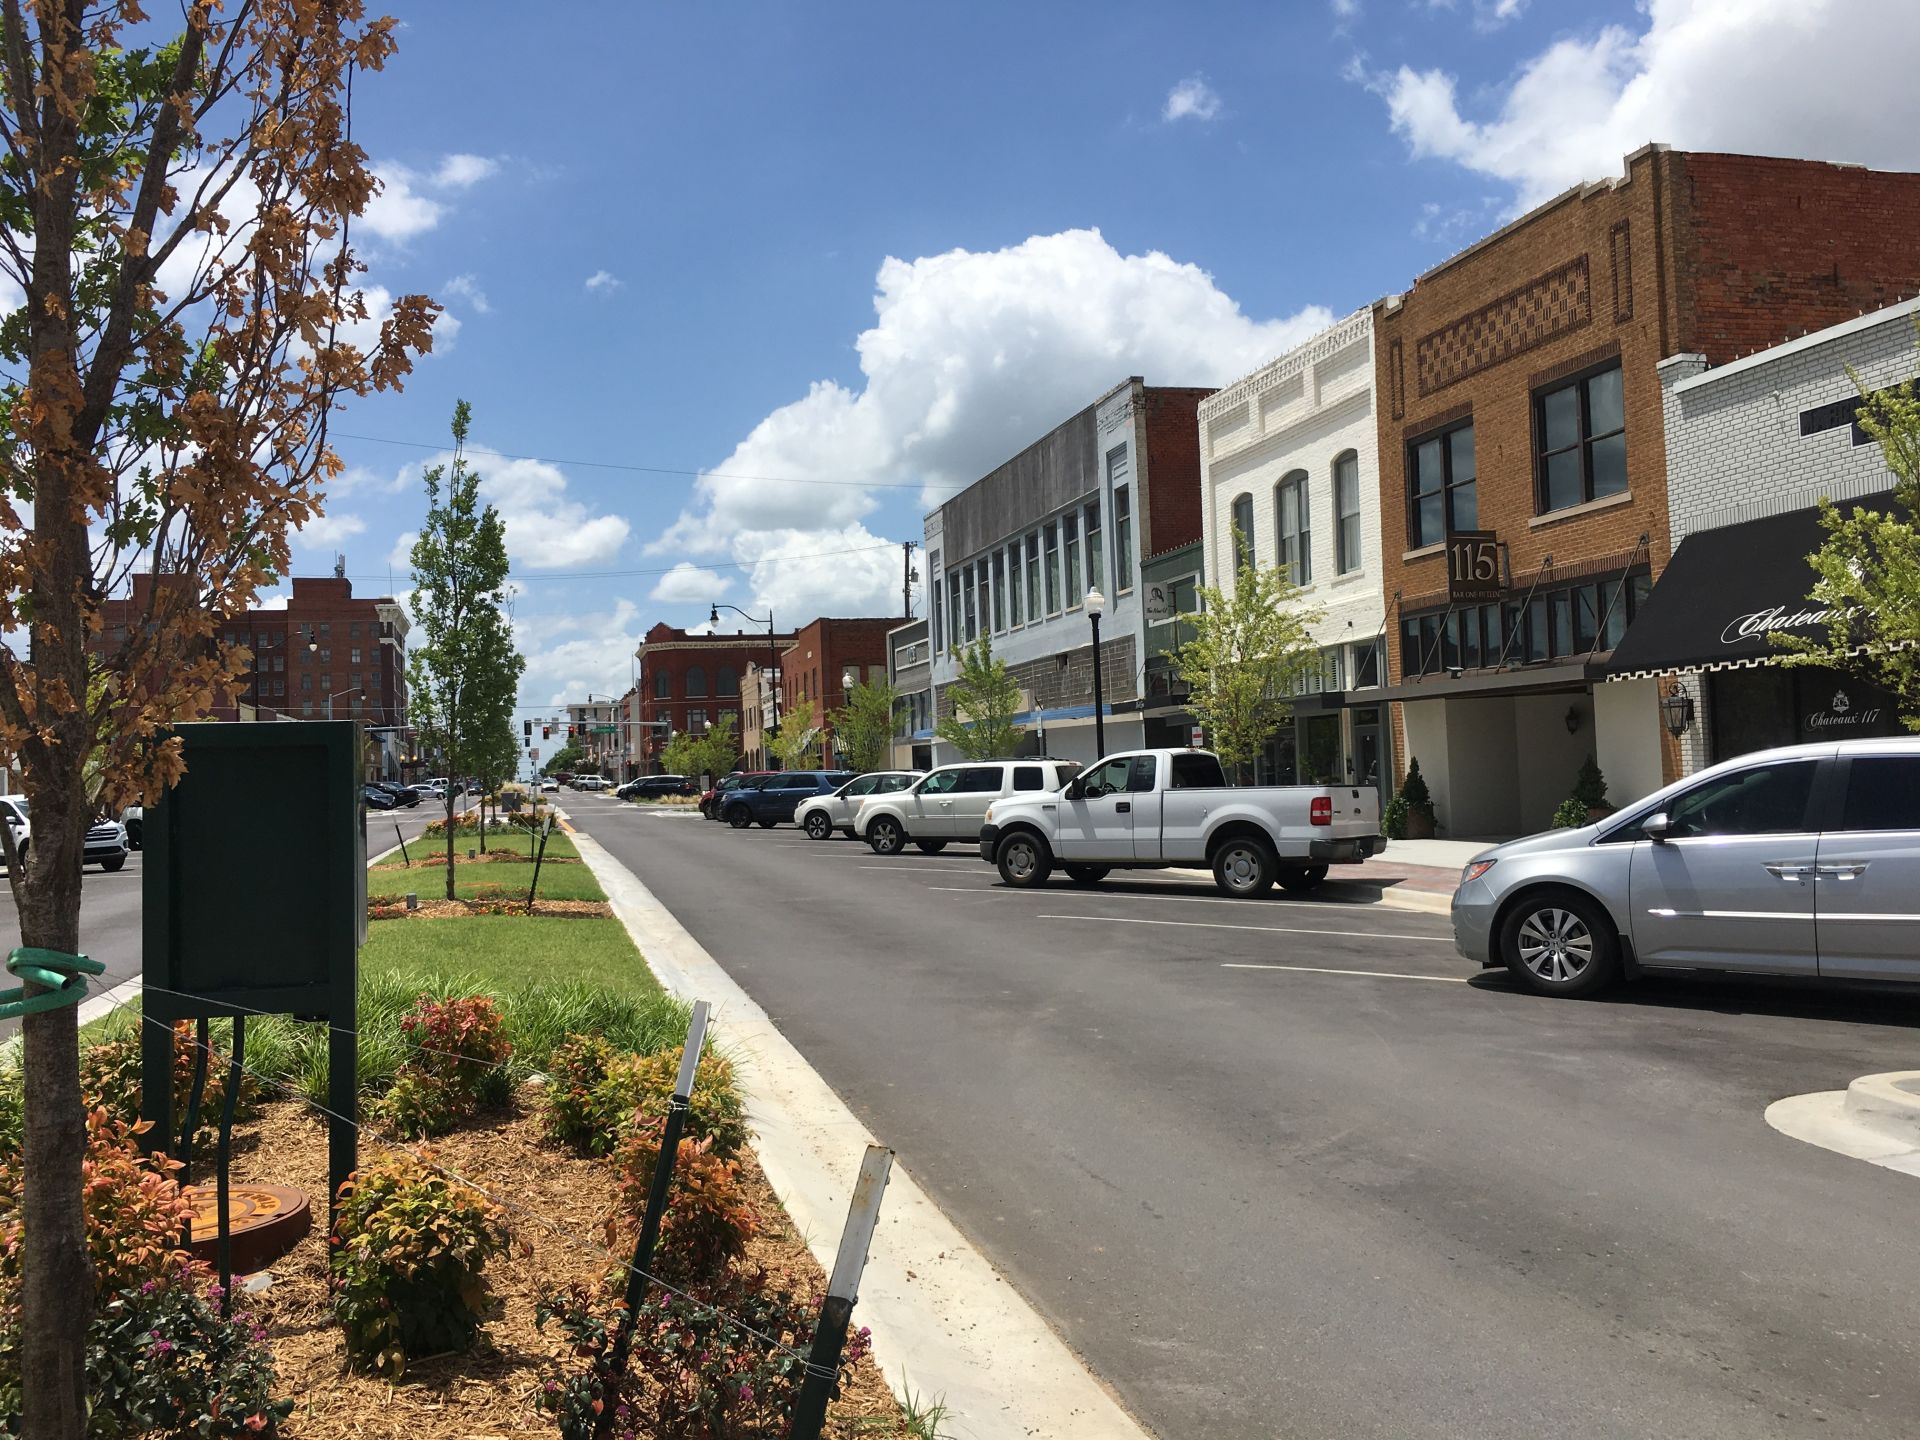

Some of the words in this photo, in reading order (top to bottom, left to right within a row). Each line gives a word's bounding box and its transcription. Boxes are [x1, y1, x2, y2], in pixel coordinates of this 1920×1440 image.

[1452, 543, 1497, 581] 115
[1804, 711, 1859, 732] Chateaux
[1861, 708, 1880, 724] 117
